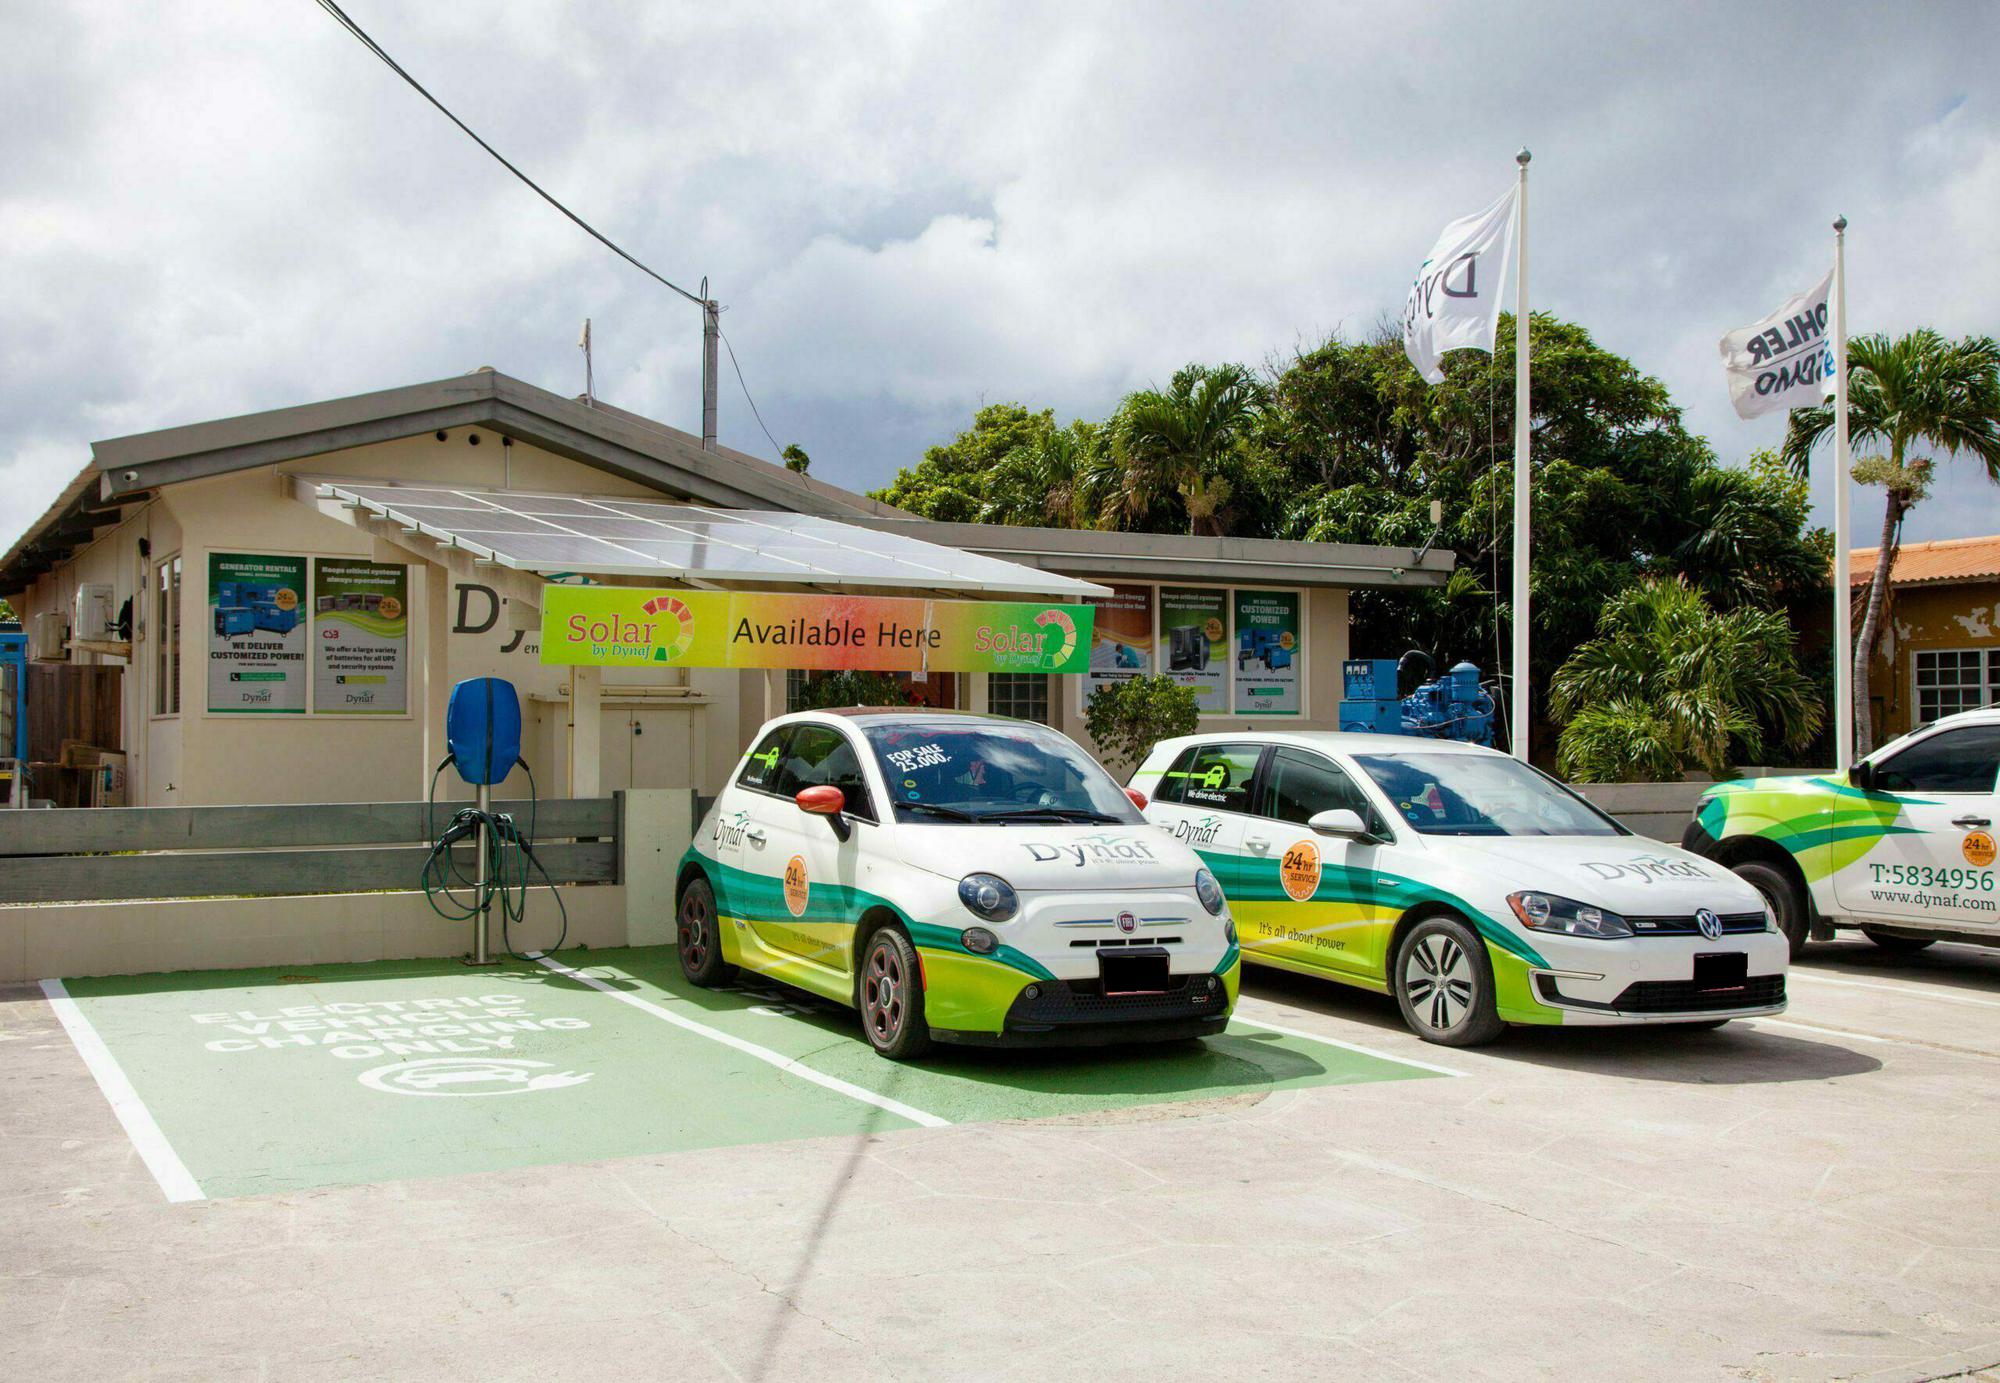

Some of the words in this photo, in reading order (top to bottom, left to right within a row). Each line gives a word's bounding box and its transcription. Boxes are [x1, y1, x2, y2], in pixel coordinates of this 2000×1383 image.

[220, 563, 264, 571] GENERATOR
[265, 565, 297, 573] RENTALS
[1241, 605, 1290, 615] CUSTOMIZED
[1250, 615, 1280, 624] POWER!
[567, 613, 658, 644] Solar
[732, 617, 866, 646] Available
[878, 622, 942, 648] Here
[975, 624, 1048, 653] Solar
[210, 652, 268, 660] CUSTOMIZED
[270, 652, 304, 660] POWER!
[232, 642, 245, 650] WE
[248, 642, 284, 650] DELIVER
[592, 643, 608, 658] by
[612, 644, 652, 660] Dynaf
[242, 692, 272, 704] Dynaf
[345, 694, 375, 704] Dynaf
[886, 750, 914, 763] FOR
[912, 744, 944, 757] SALE
[1188, 789, 1196, 798] We
[1196, 790, 1208, 800] drive
[1208, 792, 1227, 802] electric
[713, 818, 750, 850] Dynaf
[1175, 820, 1222, 845] Dynaf
[1020, 840, 1156, 867] Dynaf
[1965, 838, 1980, 850] 24
[1284, 850, 1303, 870] 24
[1303, 860, 1312, 872] hr
[786, 866, 798, 886] 24
[1290, 872, 1316, 884] SERVICE
[1869, 863, 1994, 892] T:5834956
[1870, 890, 1997, 912] www.dynaf.com
[1258, 922, 1272, 936] It's
[1274, 925, 1286, 939] all
[1288, 927, 1314, 944] about
[1315, 936, 1346, 950] power
[190, 994, 526, 1024] ELECTRIC
[223, 1007, 535, 1035] VEHICLE
[204, 1017, 592, 1052] CHARGING
[328, 1035, 515, 1059] ONLY
